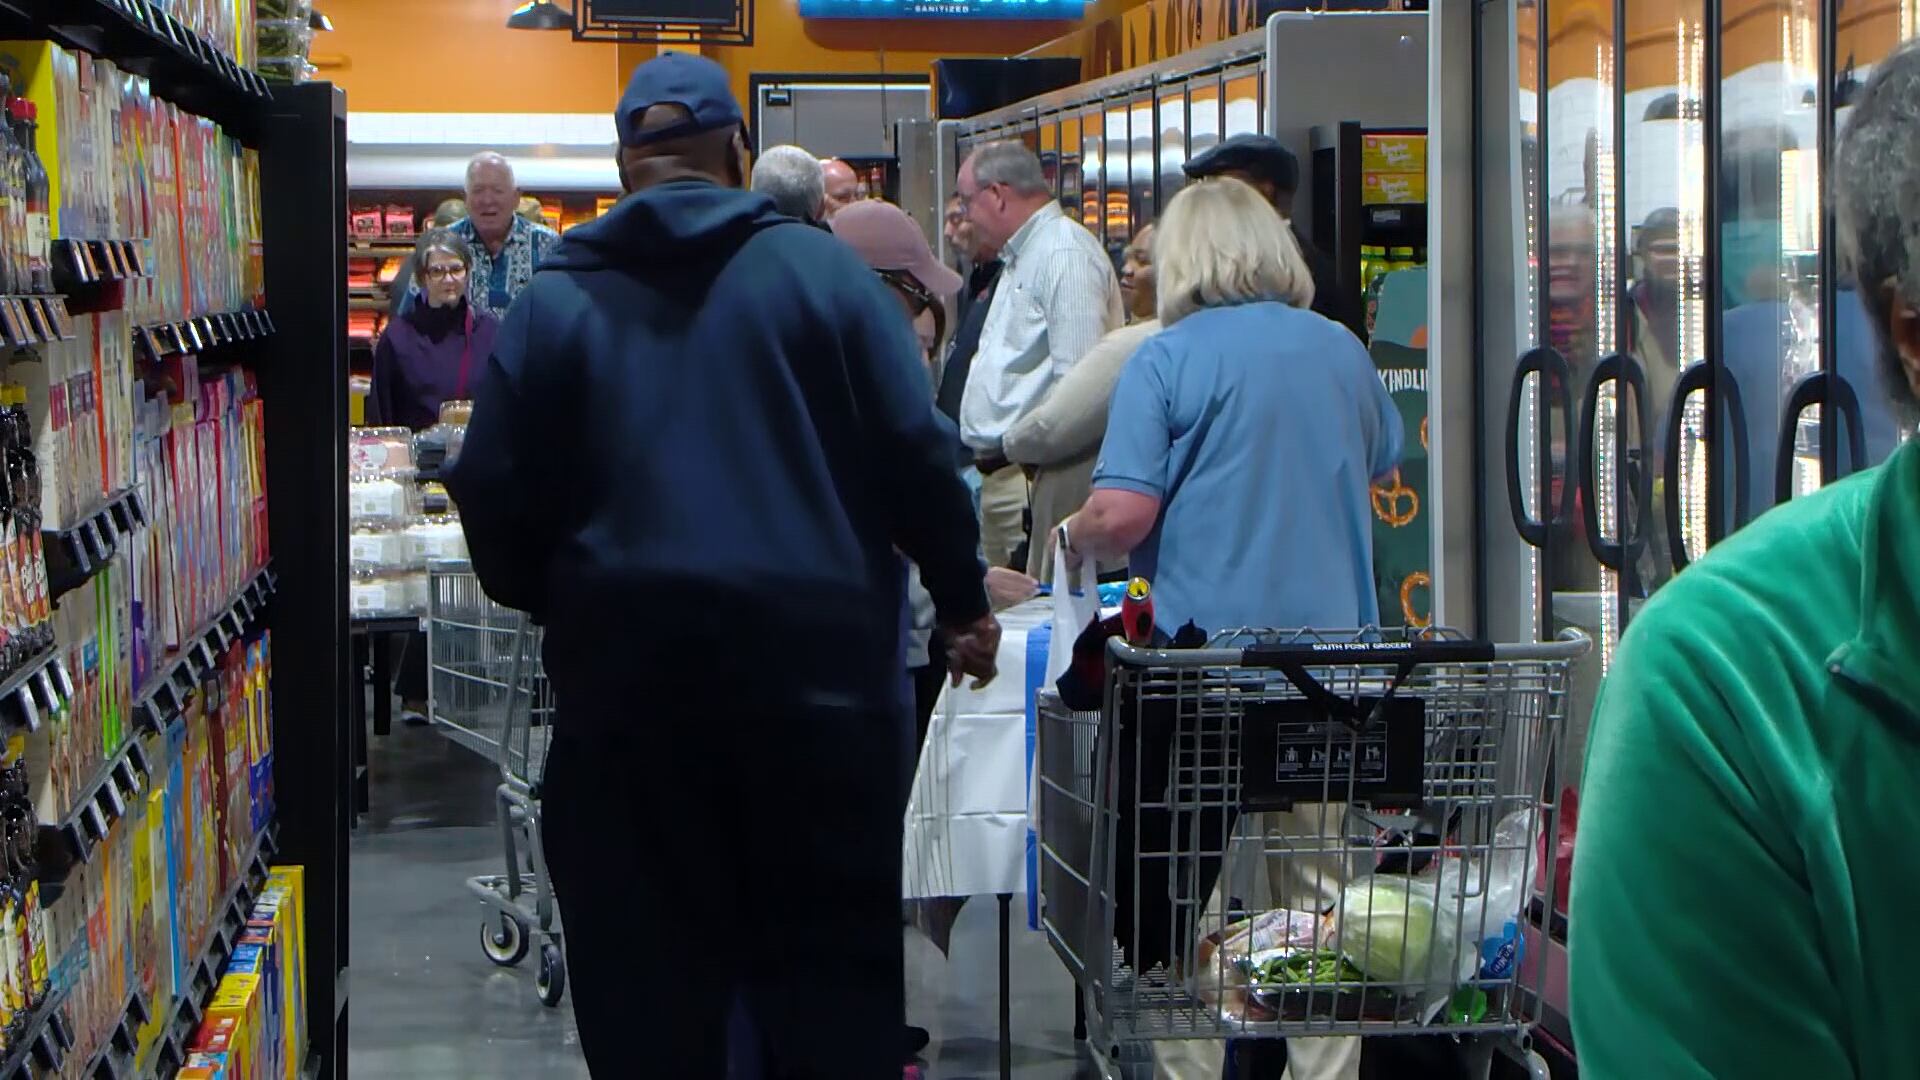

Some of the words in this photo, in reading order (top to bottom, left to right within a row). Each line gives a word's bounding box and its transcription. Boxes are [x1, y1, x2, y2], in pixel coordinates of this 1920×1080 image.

[914, 5, 969, 13] SANITIZED
[1344, 642, 1370, 650] POINT
[1372, 642, 1412, 650] GROCERY
